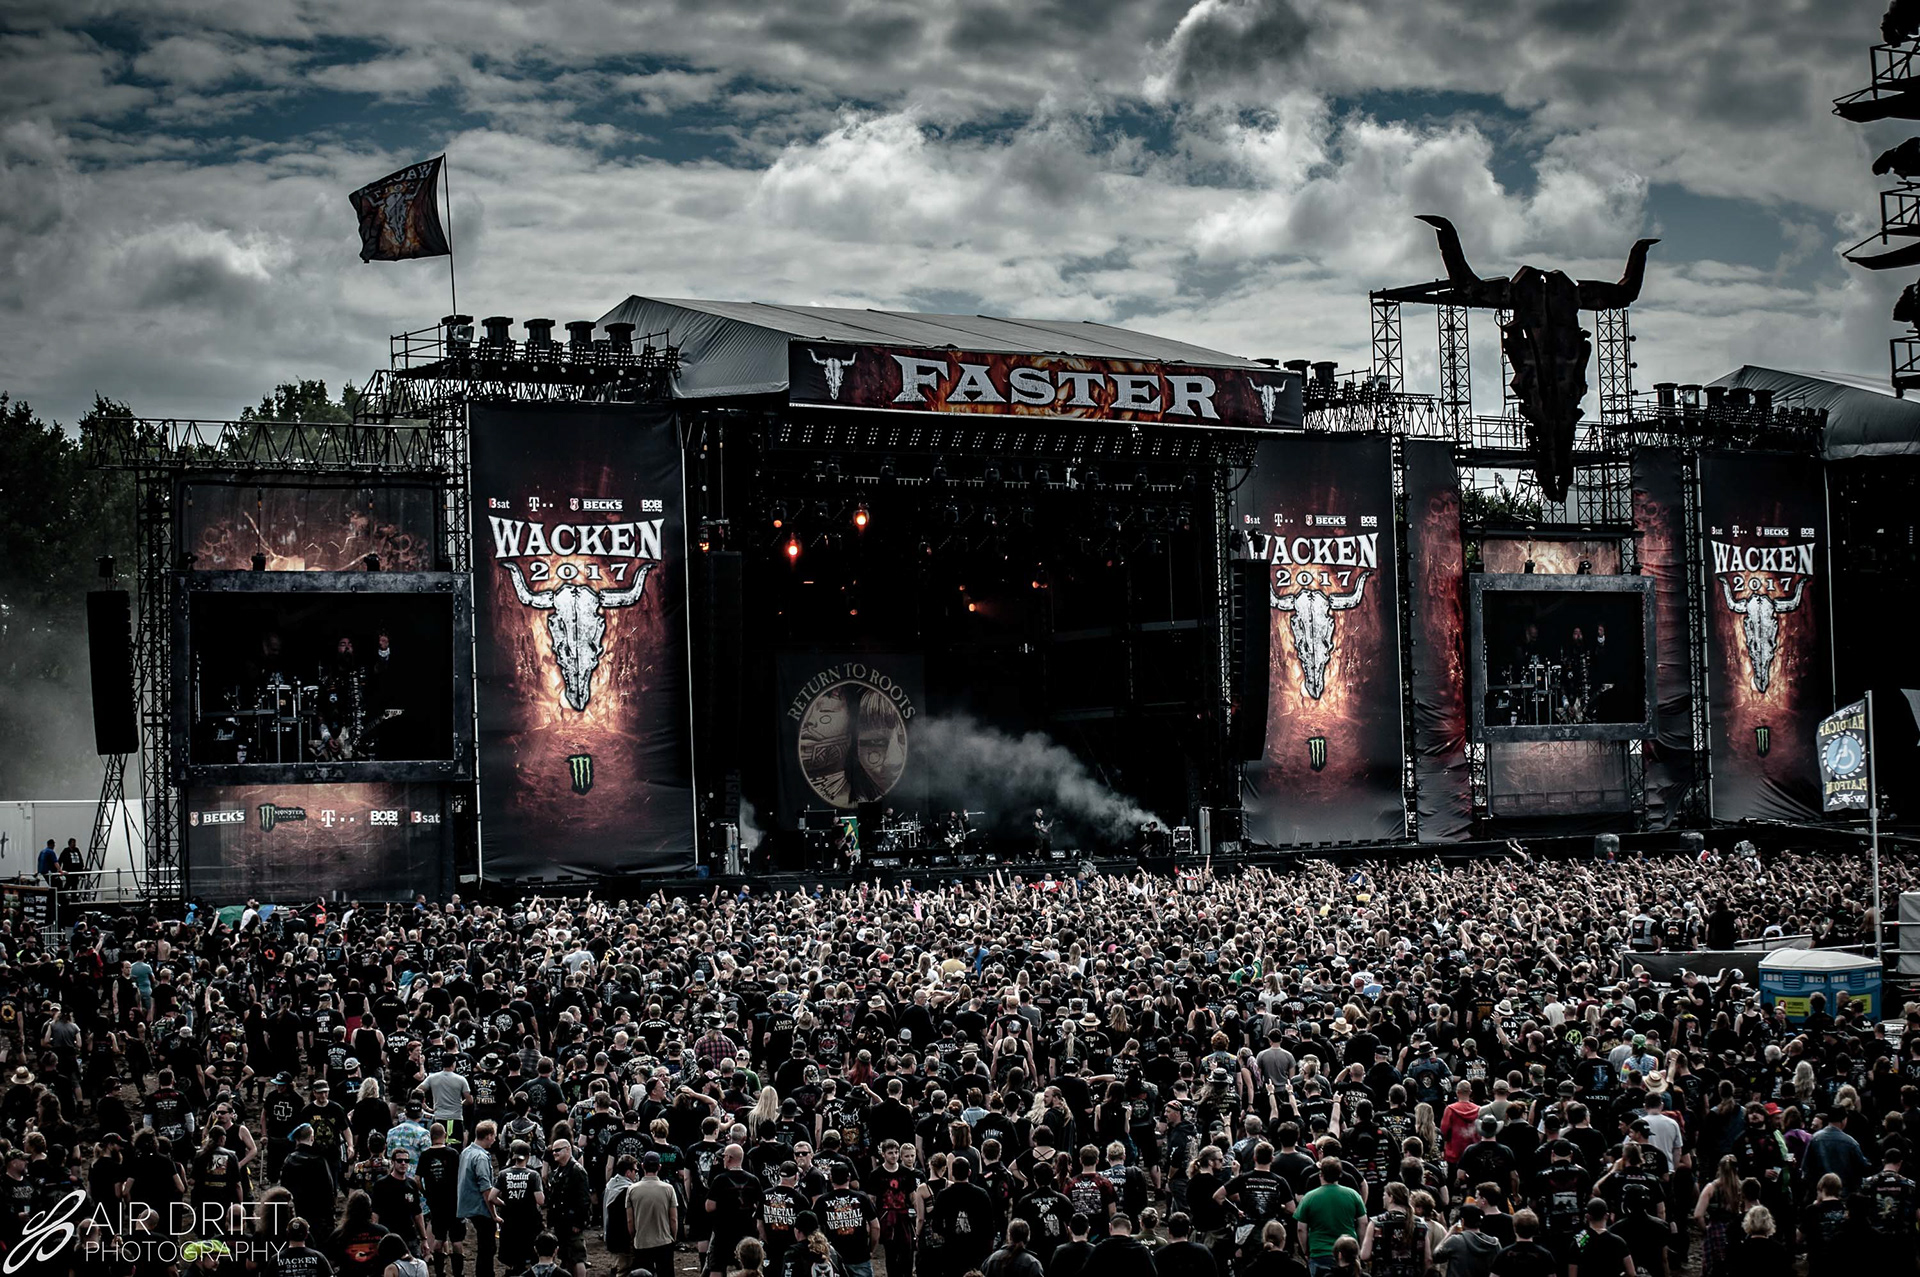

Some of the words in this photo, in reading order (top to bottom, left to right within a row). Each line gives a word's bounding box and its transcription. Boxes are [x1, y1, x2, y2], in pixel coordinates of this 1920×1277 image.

[890, 354, 1221, 421] FASTER
[488, 497, 510, 509] 3sat
[583, 499, 623, 511] BECK'S
[1244, 514, 1261, 524] 3sat
[1315, 515, 1347, 526] BECK'S
[488, 515, 665, 561] WACKEN
[1764, 528, 1790, 537] BECK'S
[1711, 540, 1816, 576] WACKEN
[530, 561, 627, 581] 2017
[1276, 570, 1352, 587] 2017
[1733, 576, 1792, 592] 2017
[787, 665, 841, 722] RETURN
[843, 661, 867, 680] TO
[869, 668, 916, 721] ROOTS
[203, 811, 245, 824] BECK'S
[371, 811, 399, 822] BOB!
[410, 811, 441, 824] 3sat
[505, 1172, 530, 1181] Dealin'
[506, 1180, 528, 1189] Death
[508, 1190, 526, 1200] 24/7
[763, 1205, 771, 1214] IN
[771, 1206, 796, 1217] METAL
[826, 1211, 835, 1221] IN
[837, 1208, 863, 1220] METAL
[763, 1214, 774, 1224] WE
[775, 1216, 797, 1226] TRUST
[827, 1219, 840, 1230] WE
[841, 1217, 863, 1228] TRUST
[278, 1256, 318, 1266] WACKEN
